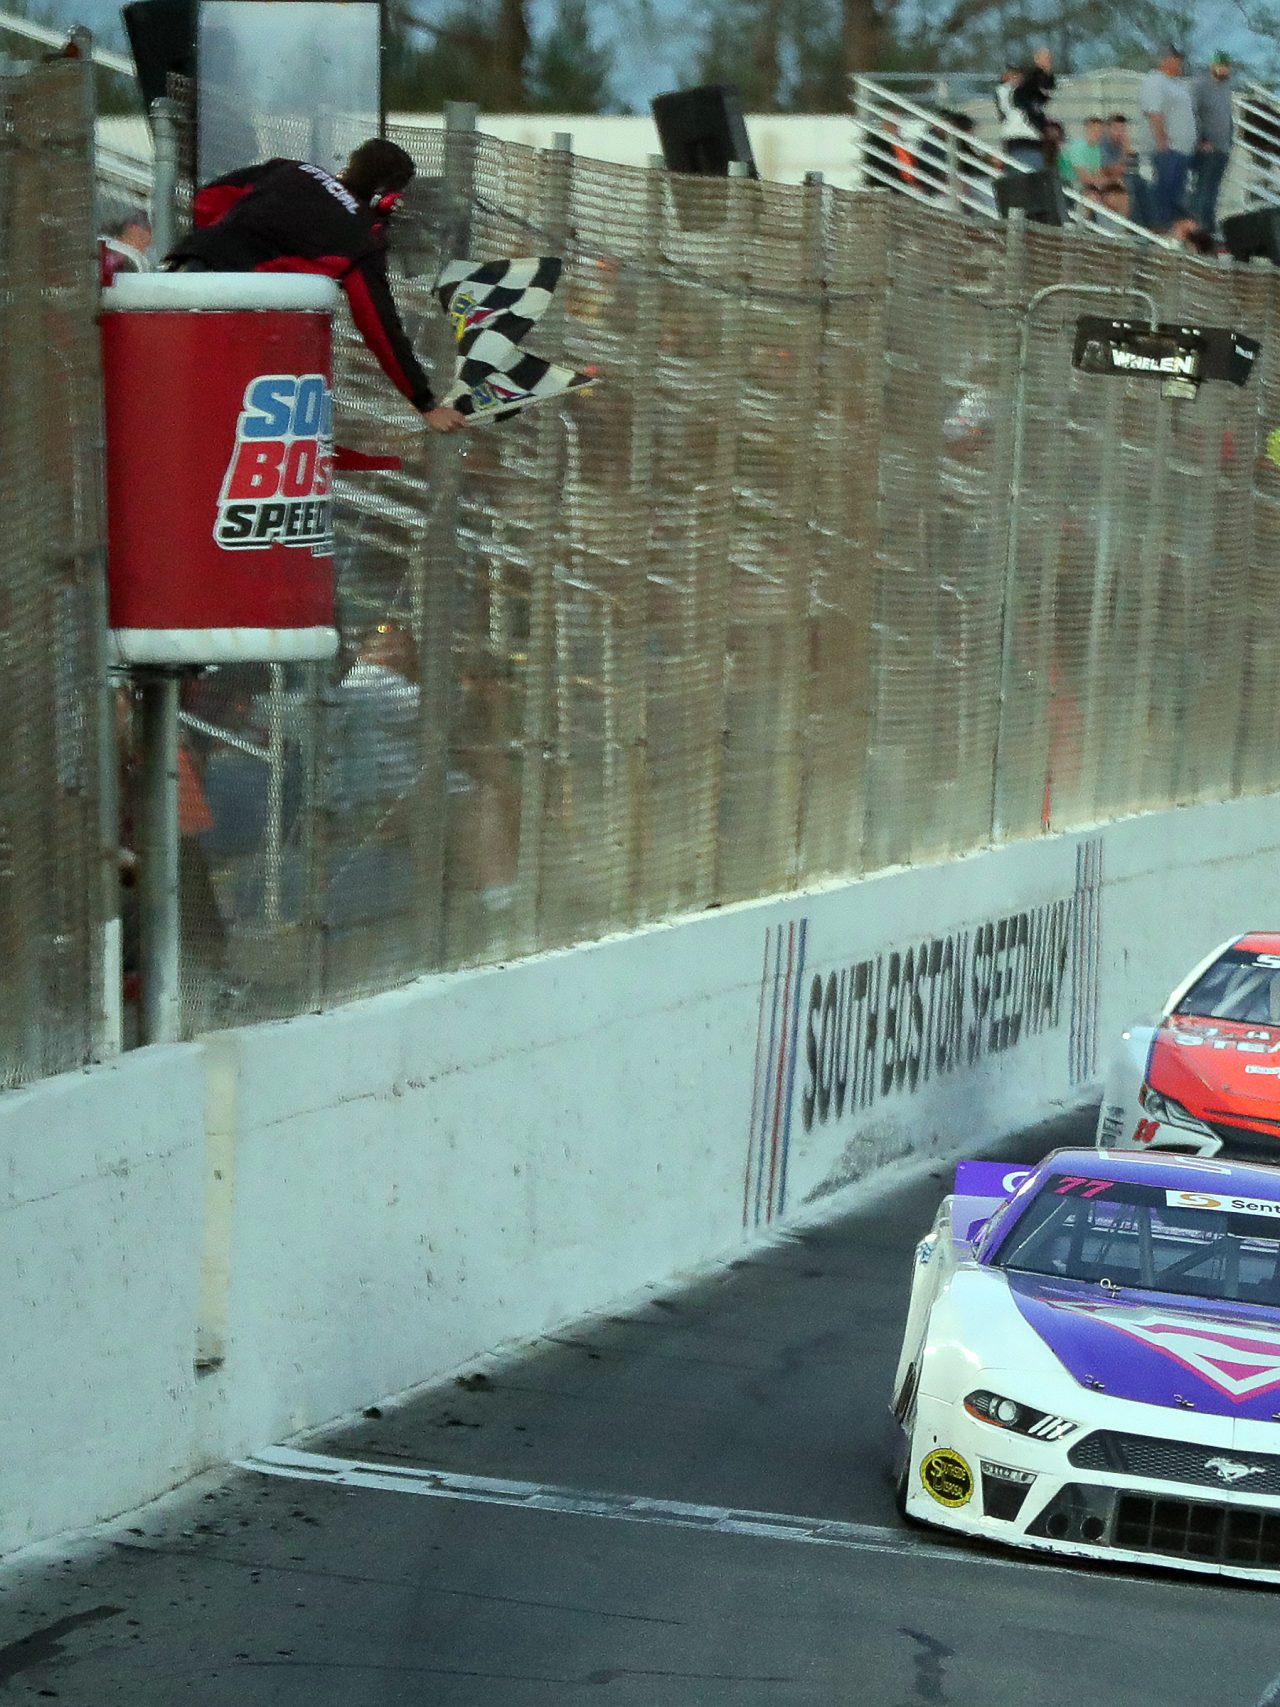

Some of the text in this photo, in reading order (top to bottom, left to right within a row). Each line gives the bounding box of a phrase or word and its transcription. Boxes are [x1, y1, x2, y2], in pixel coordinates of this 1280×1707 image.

[802, 897, 1075, 1135] SOUTH BOSTON SPEEDWAY
[1055, 1176, 1114, 1199] 77
